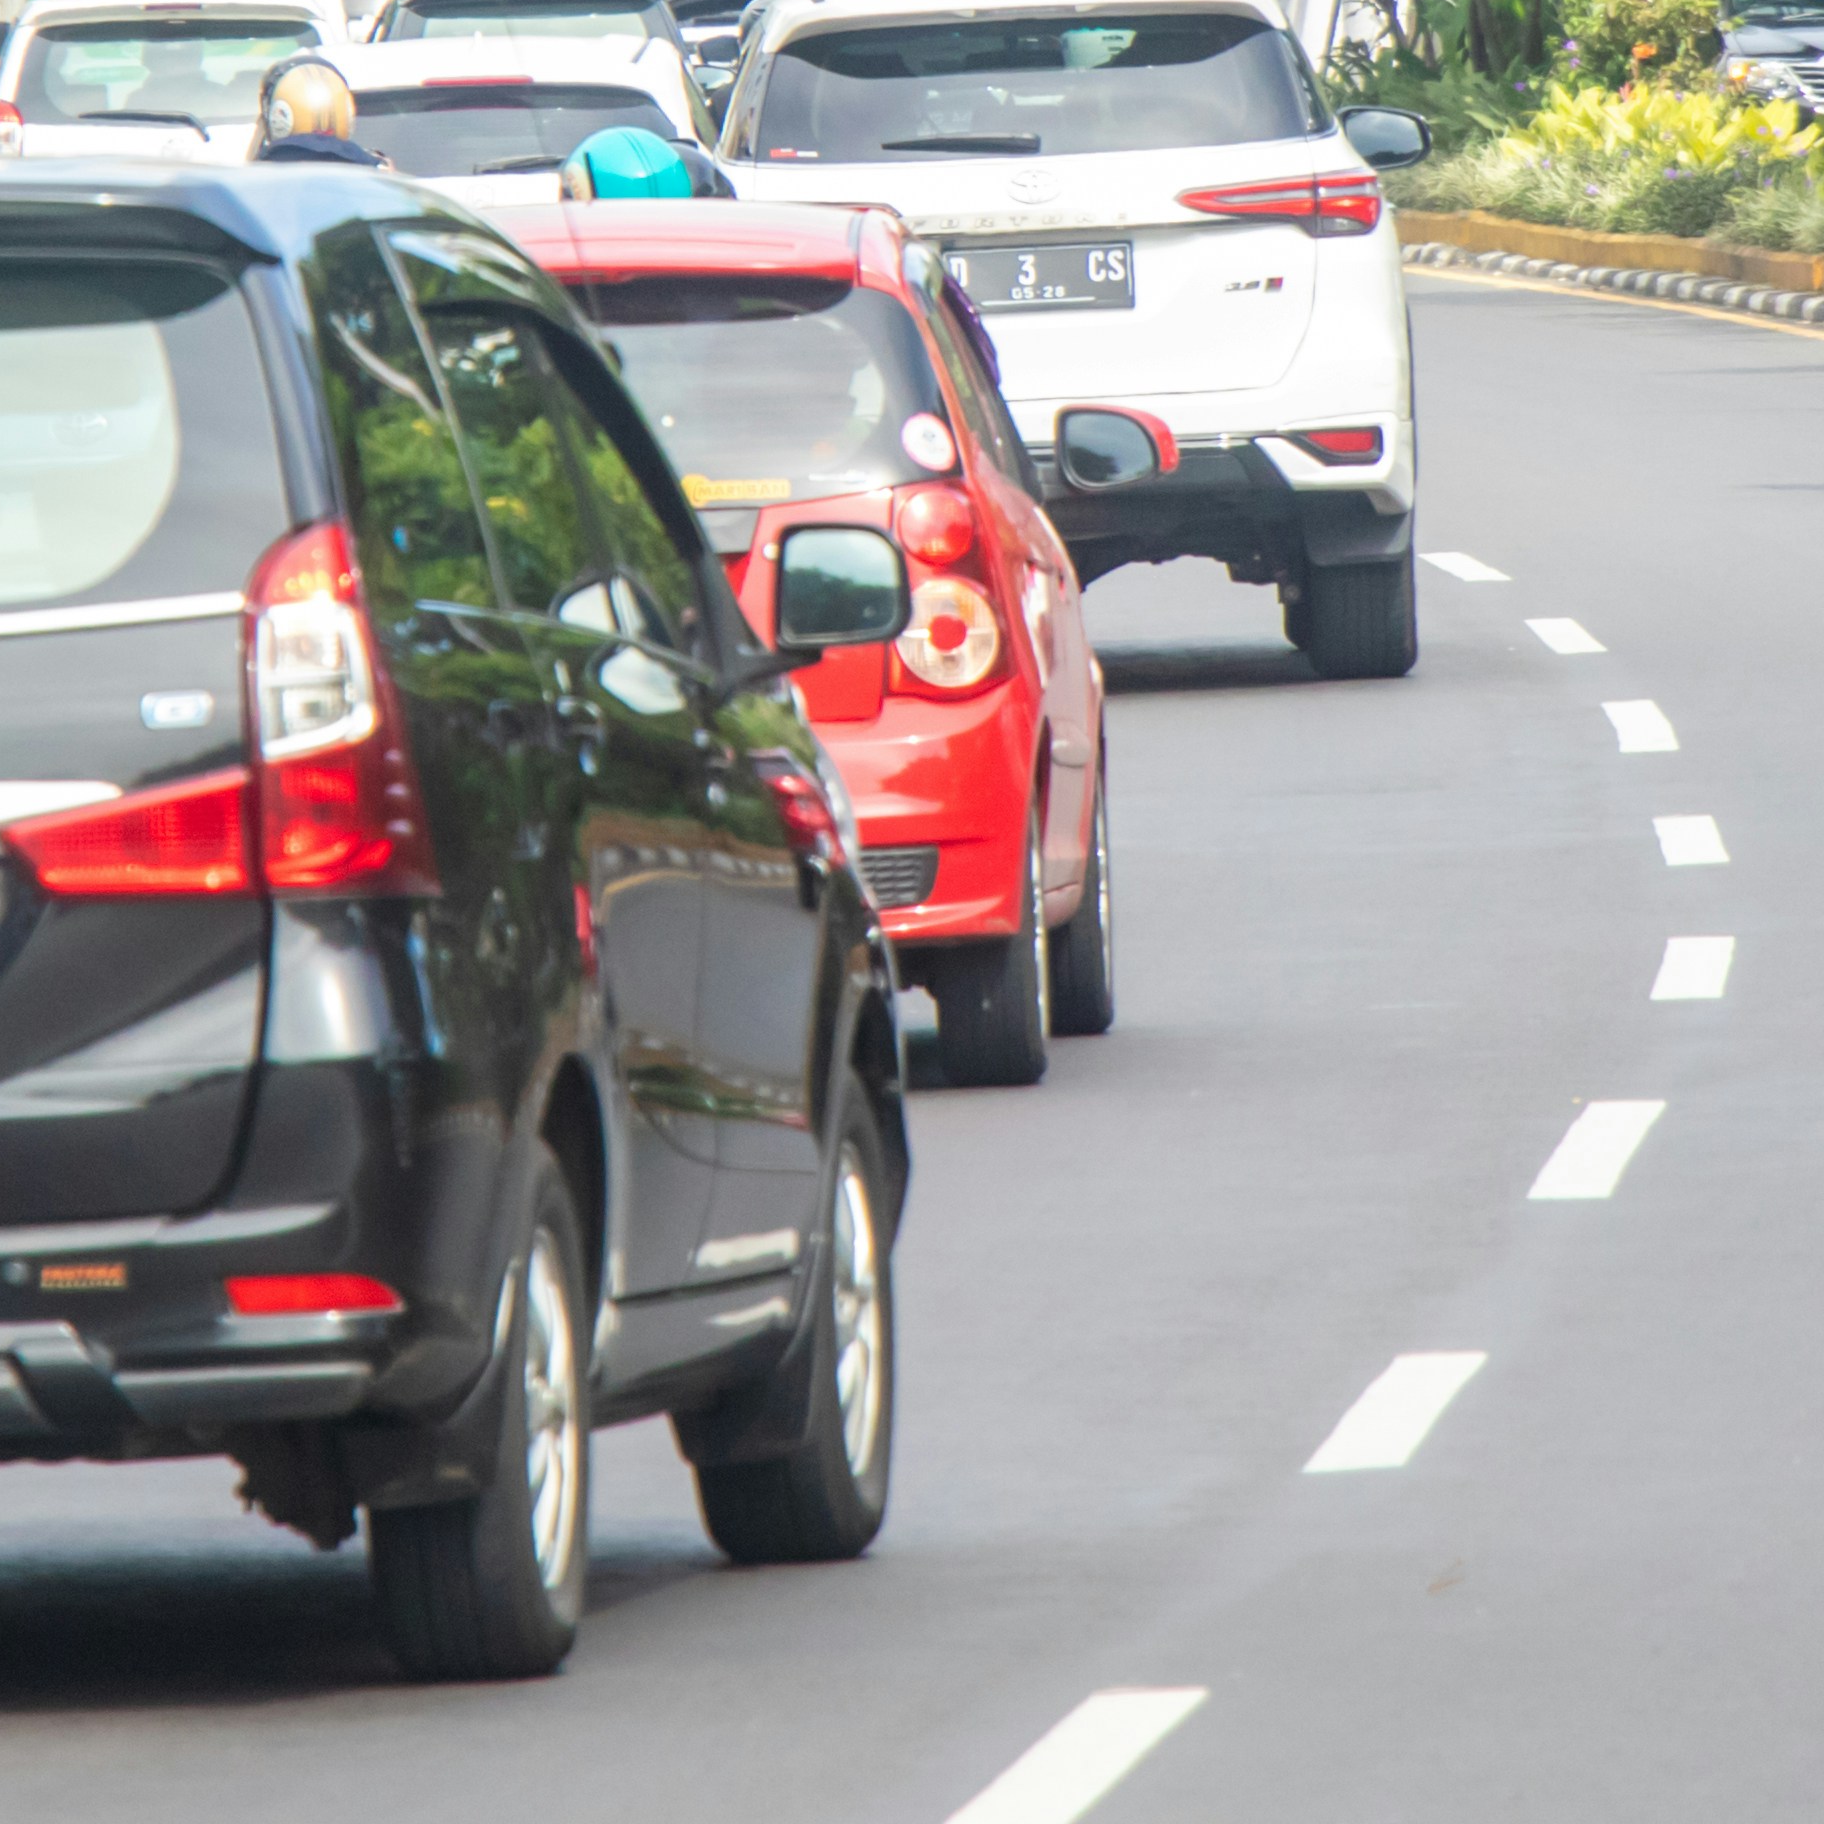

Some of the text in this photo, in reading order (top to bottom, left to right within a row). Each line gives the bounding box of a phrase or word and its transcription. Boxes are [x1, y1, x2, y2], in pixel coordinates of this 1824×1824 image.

[950, 249, 1126, 287] D 3 CS
